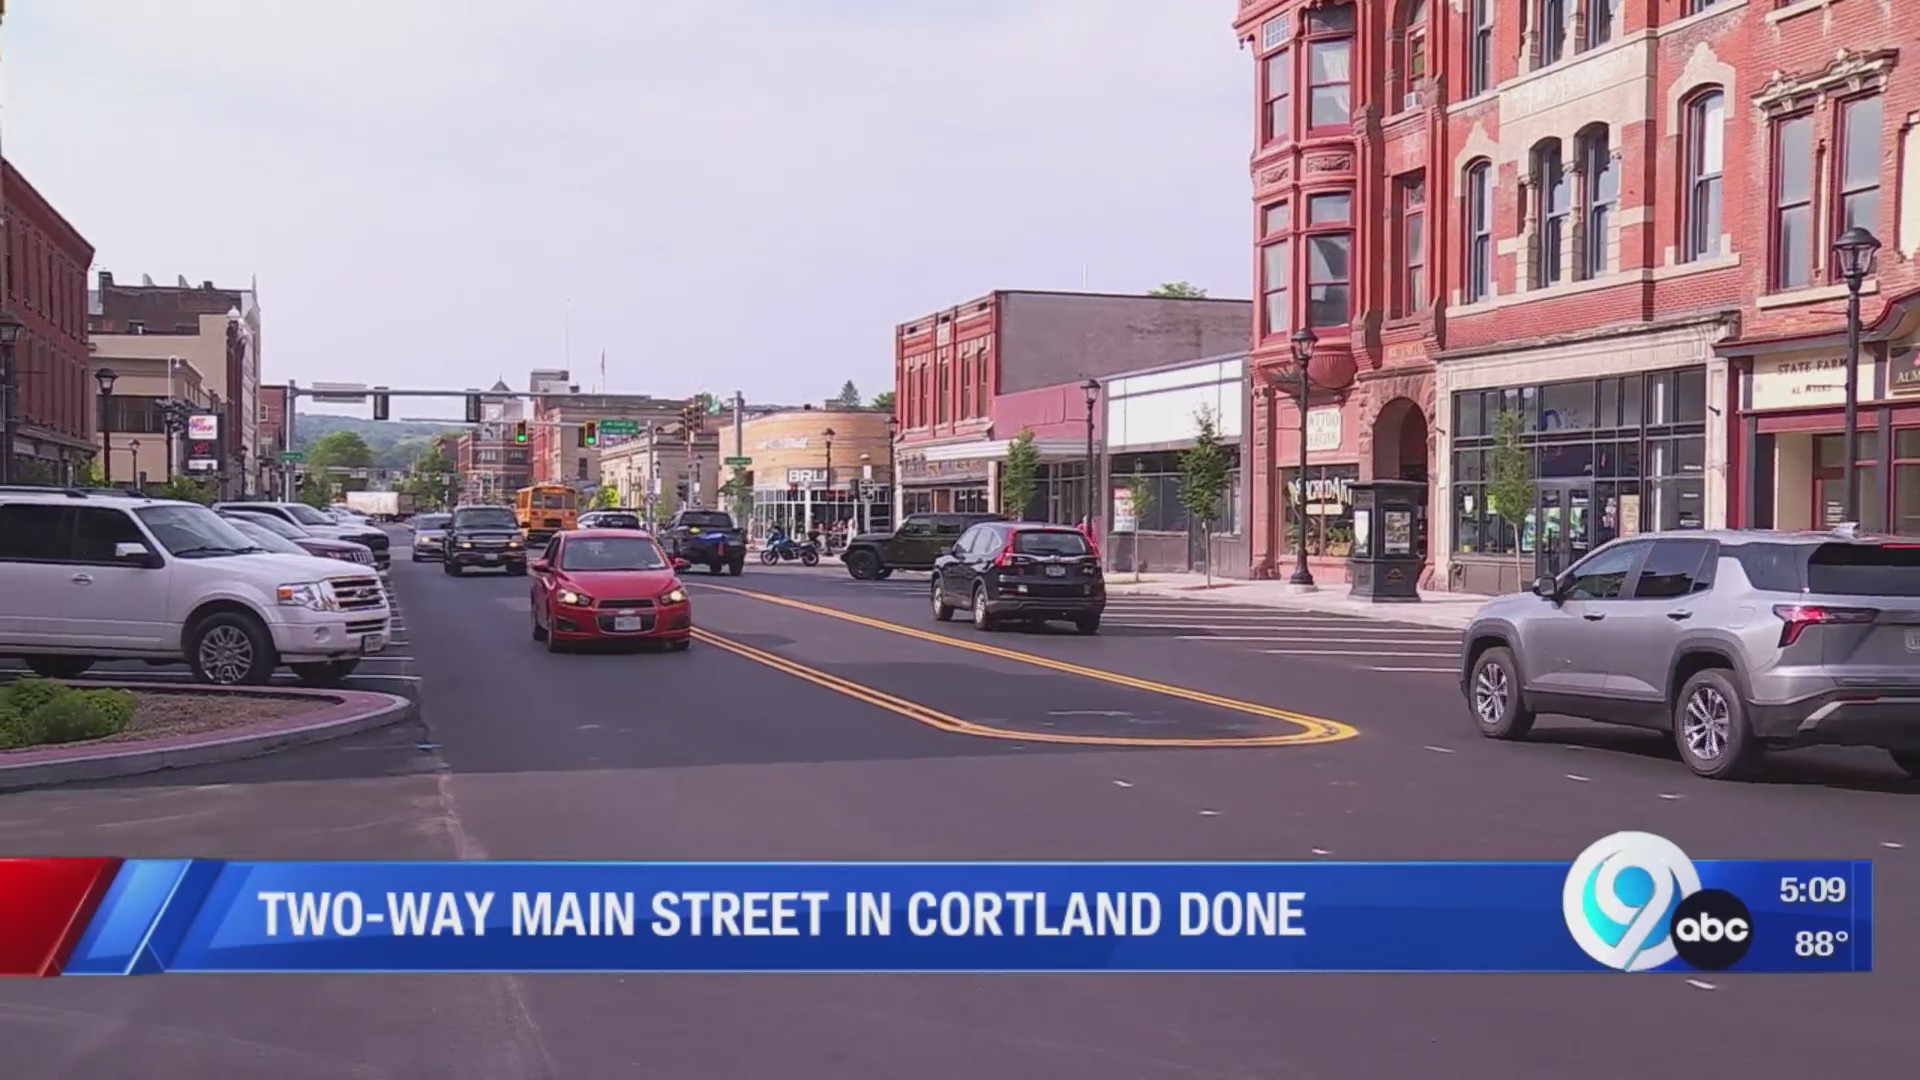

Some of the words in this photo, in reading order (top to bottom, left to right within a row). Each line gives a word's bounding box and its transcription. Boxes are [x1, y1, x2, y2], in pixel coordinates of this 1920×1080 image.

[1778, 361, 1811, 374] STATE
[1817, 358, 1849, 370] FARM
[1308, 412, 1339, 427] ATTOO
